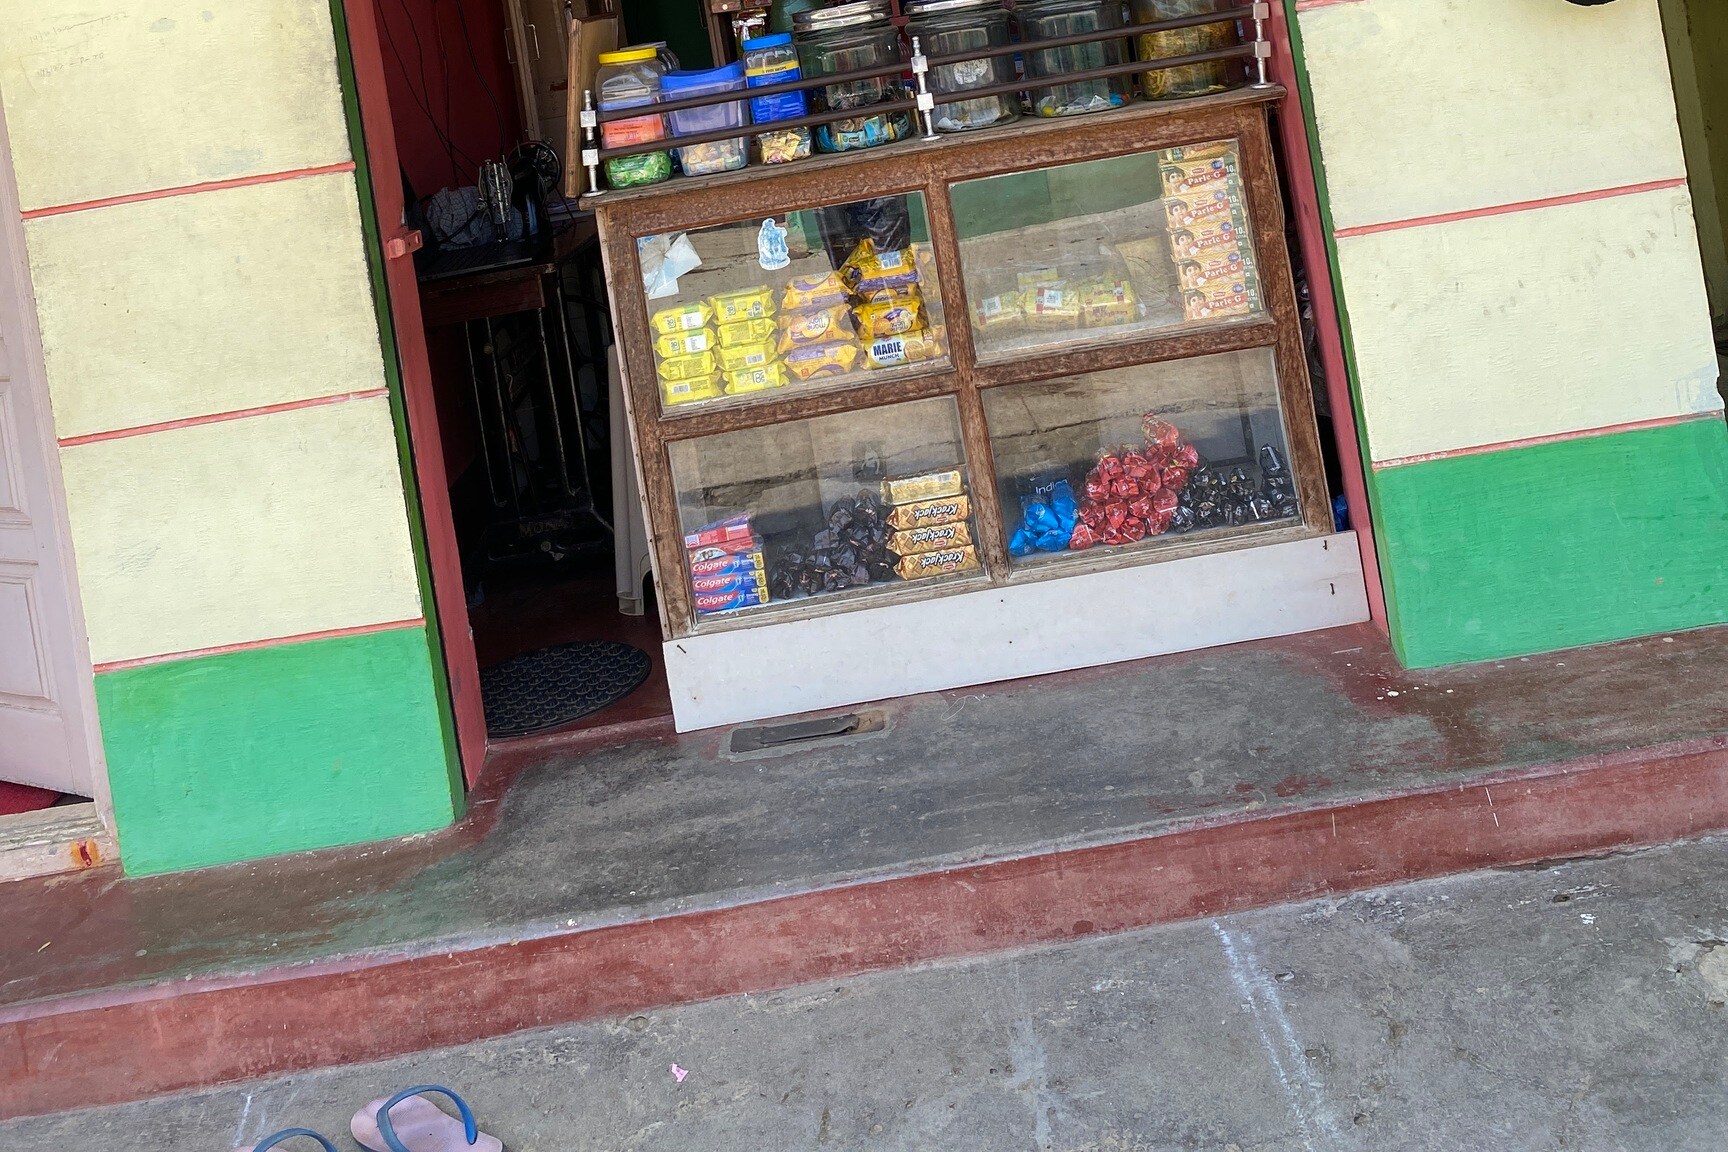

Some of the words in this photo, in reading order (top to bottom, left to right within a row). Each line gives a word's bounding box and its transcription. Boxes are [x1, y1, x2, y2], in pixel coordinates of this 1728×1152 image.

[872, 341, 903, 356] MARIE
[878, 353, 900, 361] MUNCH
[693, 560, 728, 572] Colgate
[695, 577, 731, 588] Colgate
[697, 595, 733, 605] Colgate
